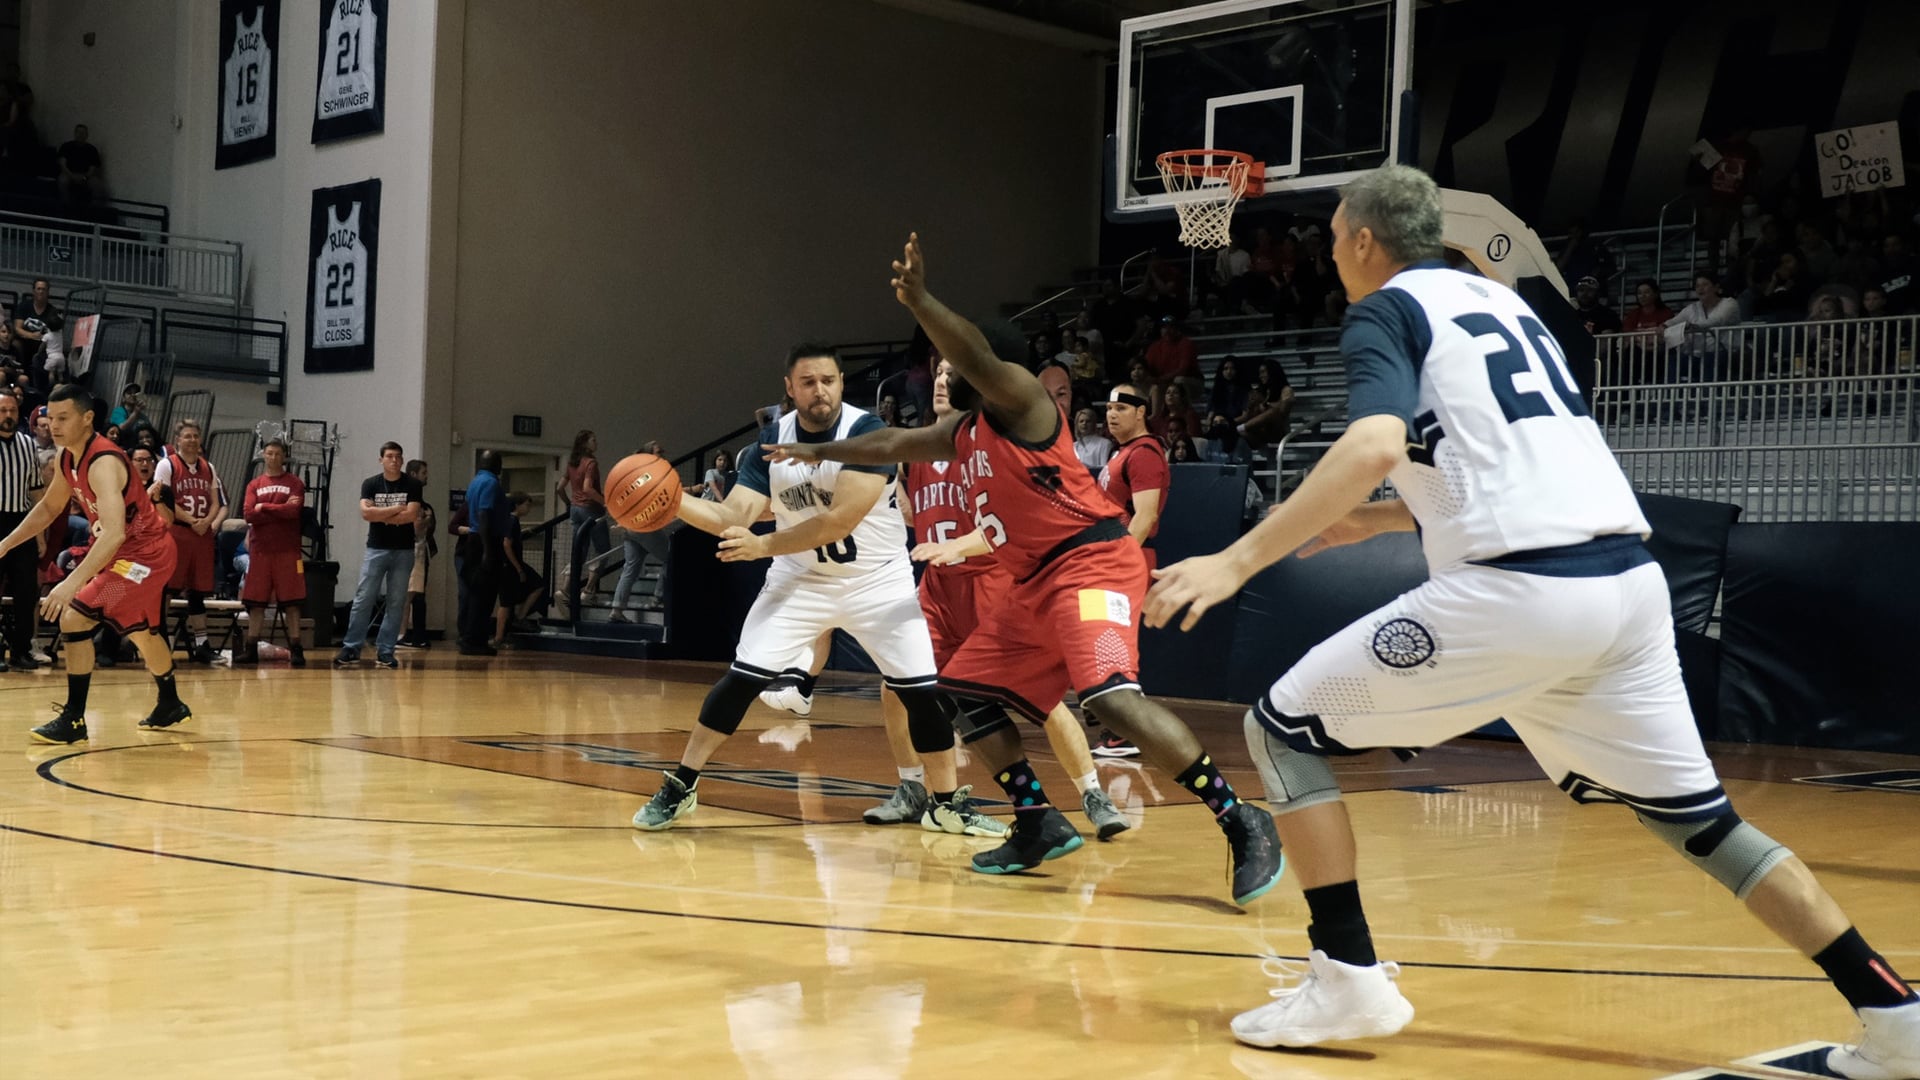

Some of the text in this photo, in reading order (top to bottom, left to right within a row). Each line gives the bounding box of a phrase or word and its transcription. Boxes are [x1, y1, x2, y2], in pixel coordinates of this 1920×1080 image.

[338, 0, 364, 20] RICE
[238, 32, 260, 54] RICE
[336, 27, 360, 76] 21
[236, 62, 258, 107] 16
[338, 85, 353, 96] GENE
[324, 92, 369, 113] SCHWINGER
[234, 123, 256, 137] HENRY
[1821, 129, 1857, 159] GO!
[1831, 166, 1892, 192] JACOB
[329, 229, 356, 252] RICE
[325, 262, 355, 308] 22
[327, 318, 350, 328] BILL TOM
[324, 329, 352, 342] CLOSS
[1450, 312, 1594, 424] 20
[176, 478, 210, 493] MARTYR
[183, 495, 207, 517] 32
